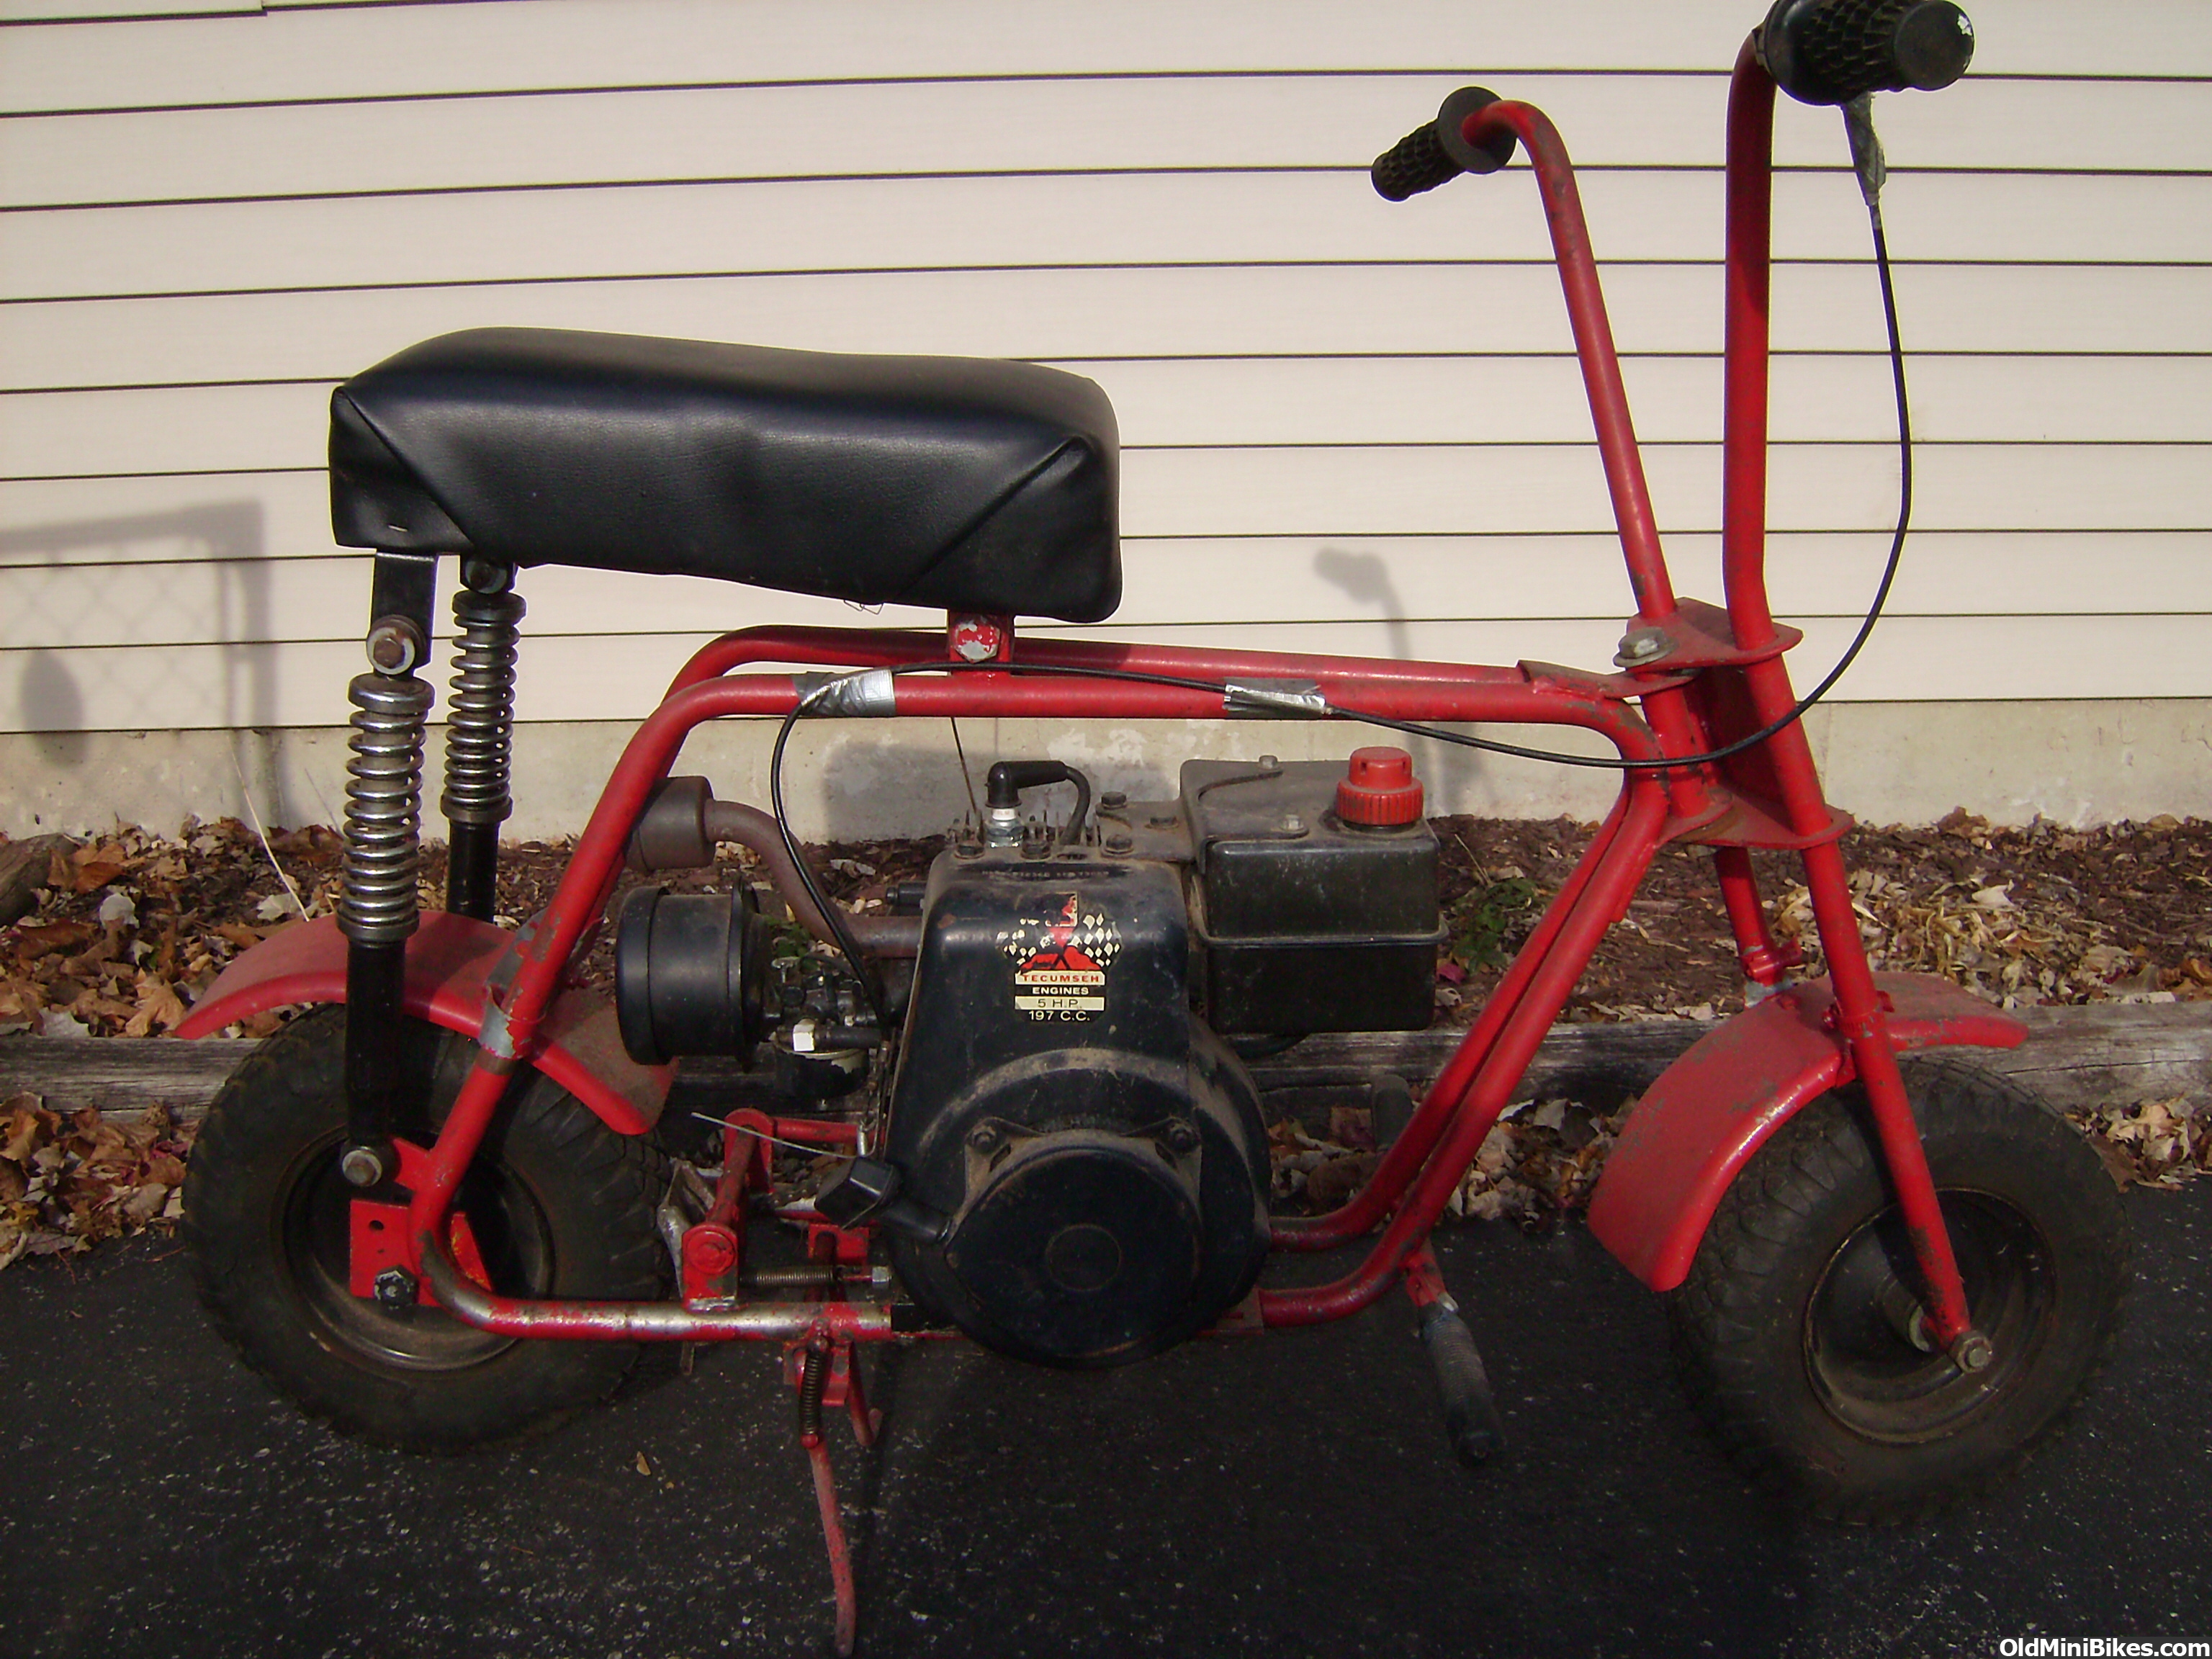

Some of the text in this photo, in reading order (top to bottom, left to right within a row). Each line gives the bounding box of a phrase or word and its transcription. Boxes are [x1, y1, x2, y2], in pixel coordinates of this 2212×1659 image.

[1022, 974, 1100, 983] TECUMSEH
[1032, 986, 1089, 995] ENGINES
[1038, 999, 1082, 1009] 5 H.P.
[1029, 1010, 1090, 1021] 197 C.C.
